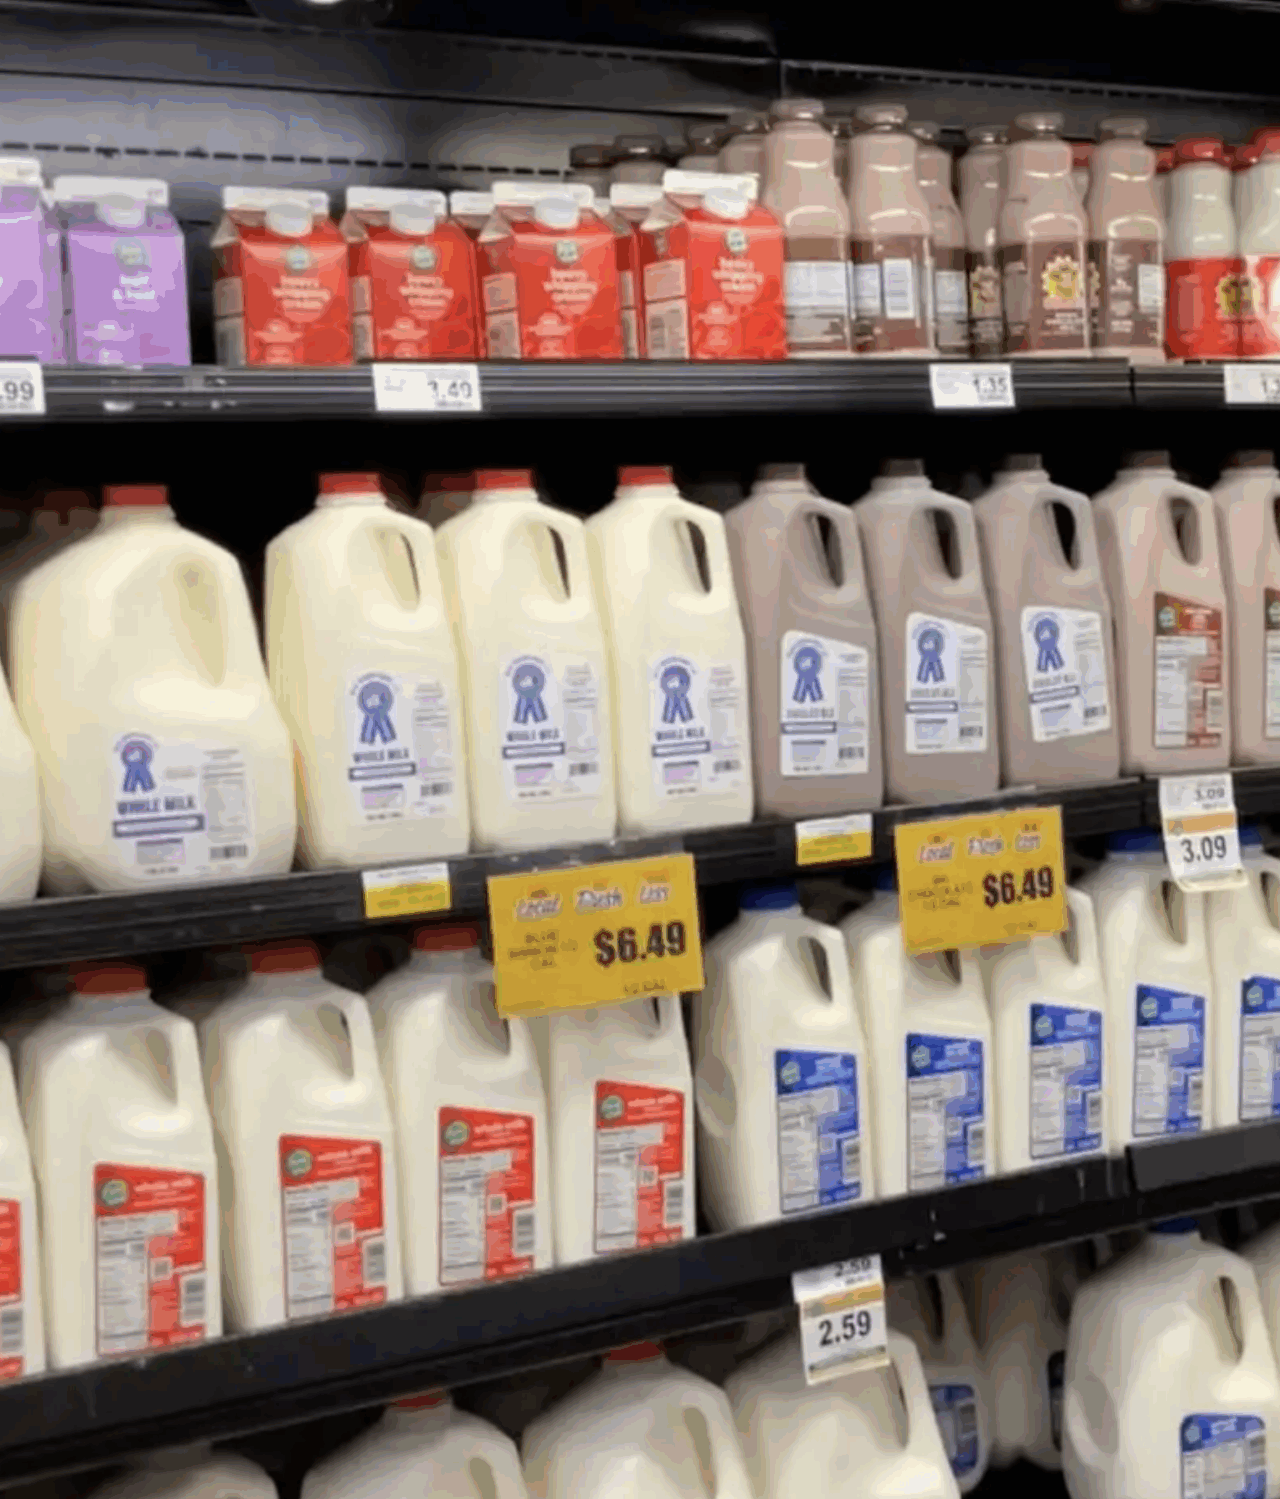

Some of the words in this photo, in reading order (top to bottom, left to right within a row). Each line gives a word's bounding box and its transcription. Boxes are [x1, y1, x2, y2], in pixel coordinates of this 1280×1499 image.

[1180, 834, 1228, 863] 3.09
[982, 865, 1054, 910] $6.49
[593, 920, 687, 968] $6.49
[818, 1309, 872, 1348] 2.59
